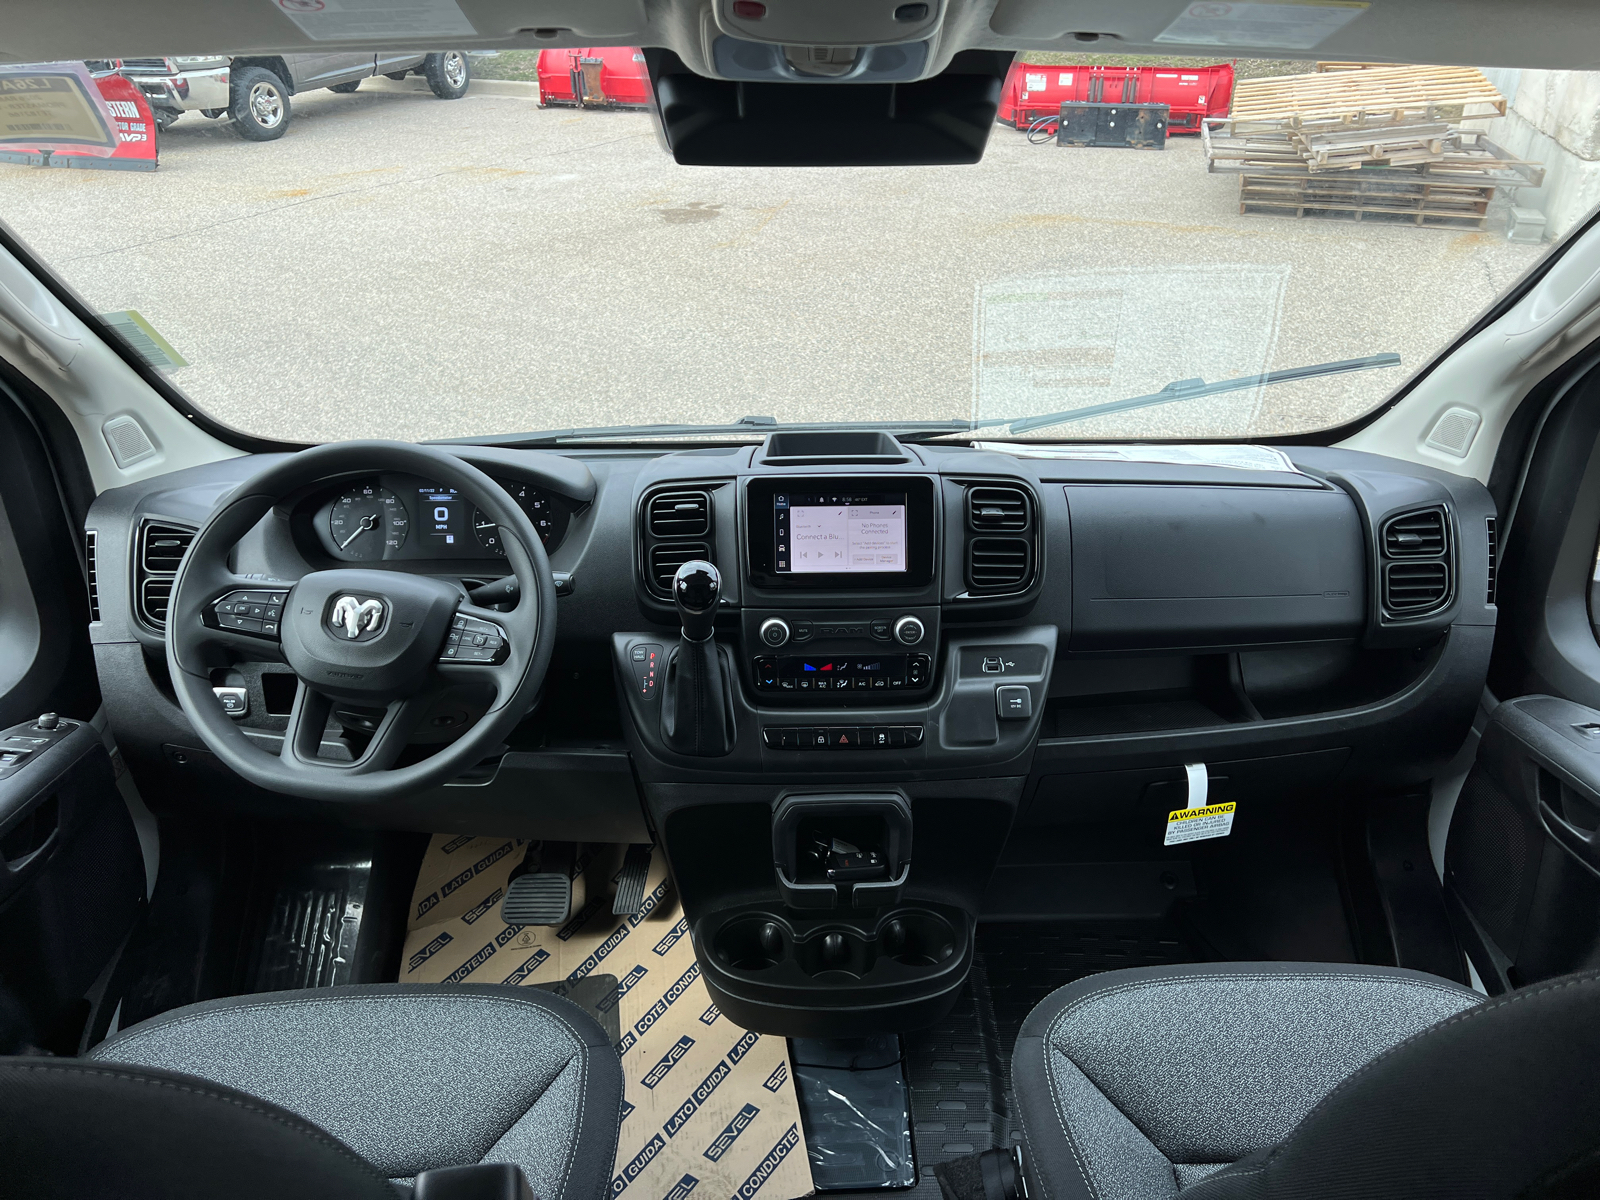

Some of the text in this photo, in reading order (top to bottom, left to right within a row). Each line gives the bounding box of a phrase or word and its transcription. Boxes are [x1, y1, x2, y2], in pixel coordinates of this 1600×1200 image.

[106, 101, 140, 118] STERN
[130, 122, 146, 131] GRADE
[434, 506, 449, 521] 0
[1180, 804, 1234, 818] WARNING
[1176, 826, 1208, 834] PASSENGER
[418, 846, 511, 914] IDA LATO GUIDA
[465, 890, 504, 923] SEVE
[598, 928, 628, 957] GUIDA
[631, 900, 654, 924] LATO
[656, 919, 688, 954] SEVE
[409, 937, 450, 970] EVEL
[504, 954, 547, 985] EVEL
[601, 970, 645, 1012] SEVEL
[667, 962, 700, 1001] CONDU
[645, 1040, 693, 1087] SEVEL
[697, 1033, 755, 1100] GUIDA LATO
[628, 1103, 694, 1177] GUIDA LATO
[708, 1109, 756, 1159] SEVEL
[742, 1128, 799, 1198] CONDUCTE
